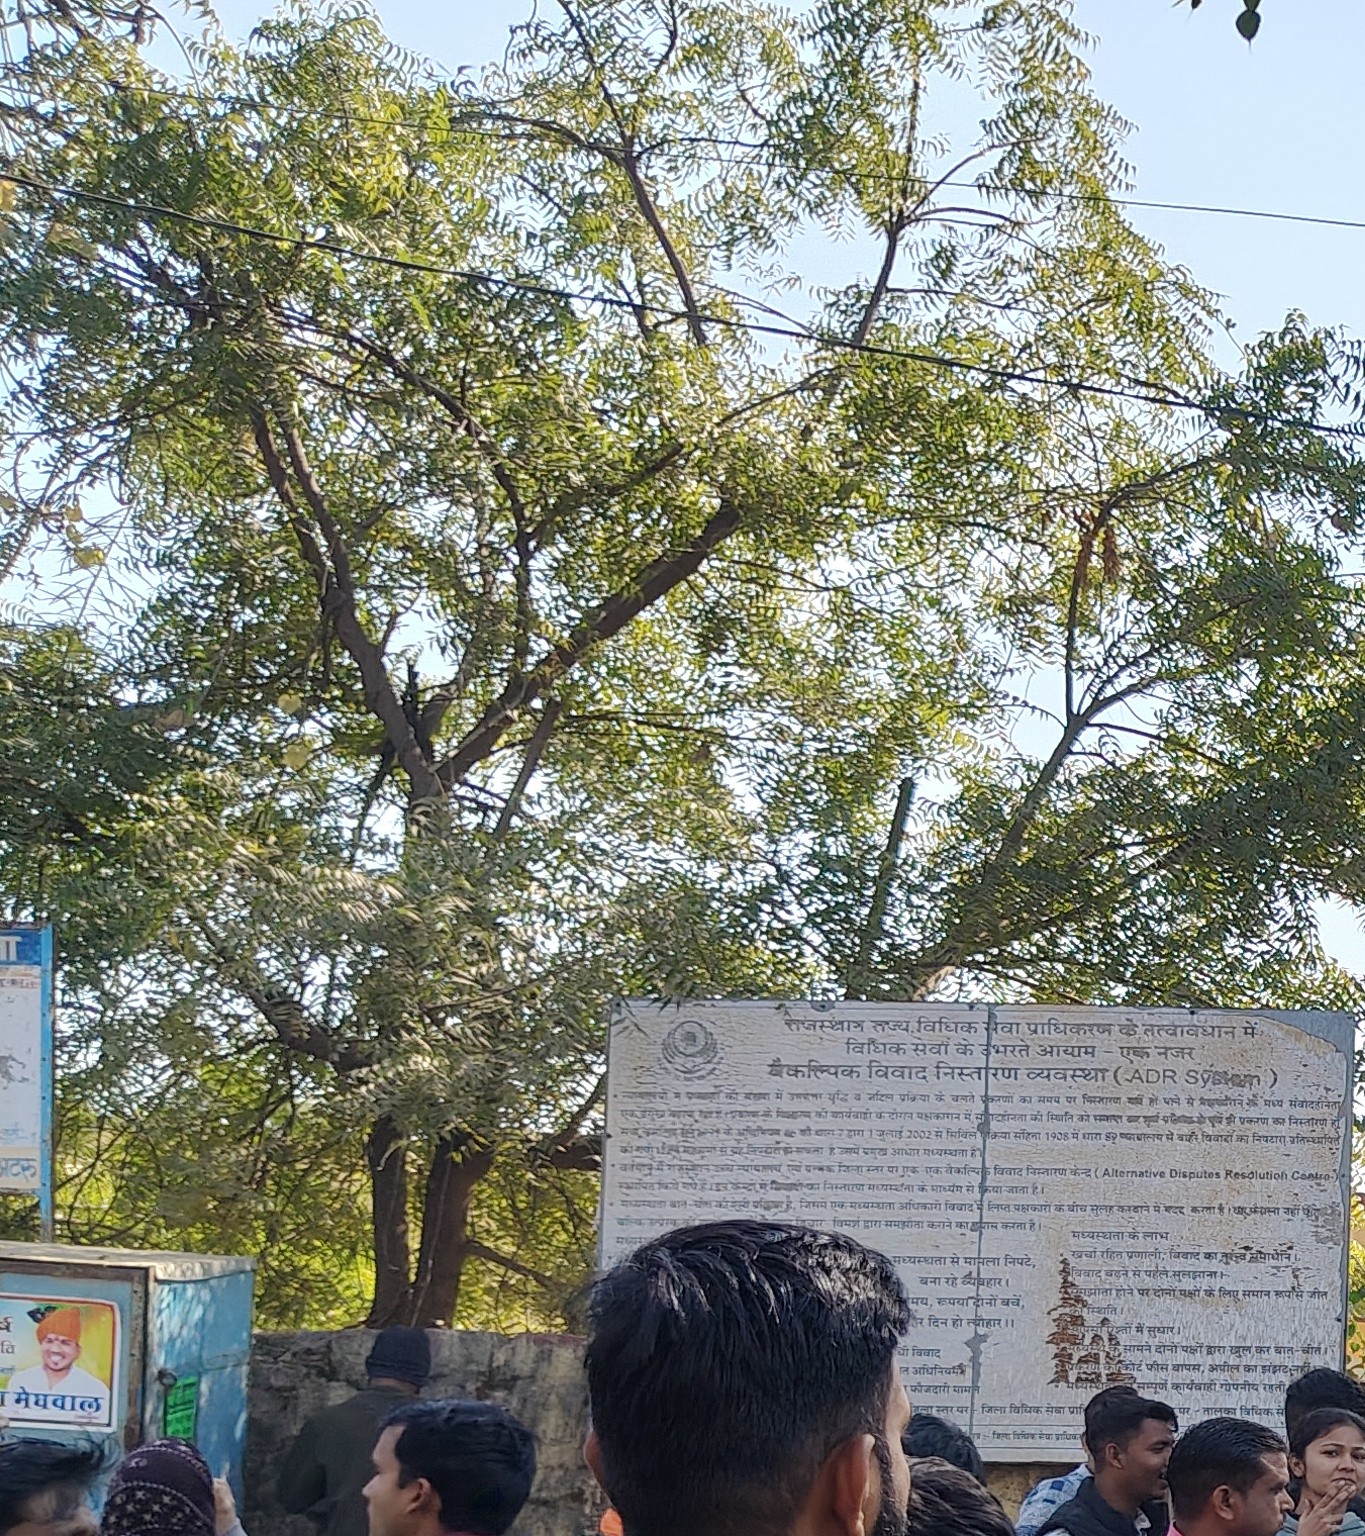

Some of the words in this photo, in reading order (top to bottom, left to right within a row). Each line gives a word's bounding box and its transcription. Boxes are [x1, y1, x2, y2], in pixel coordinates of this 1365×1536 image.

[916, 1016, 979, 1034] विधिक
[846, 1038, 908, 1057] विधिक
[954, 1040, 975, 1057] के
[868, 1060, 929, 1082] विवाद
[1026, 1067, 1108, 1084] व्यवस्था
[906, 1131, 932, 1139] 2002
[1143, 1231, 1170, 1242] लाभ
[1138, 1289, 1150, 1300] पर
[929, 1315, 948, 1328] दिन
[14, 1386, 104, 1413] मेघवाल
